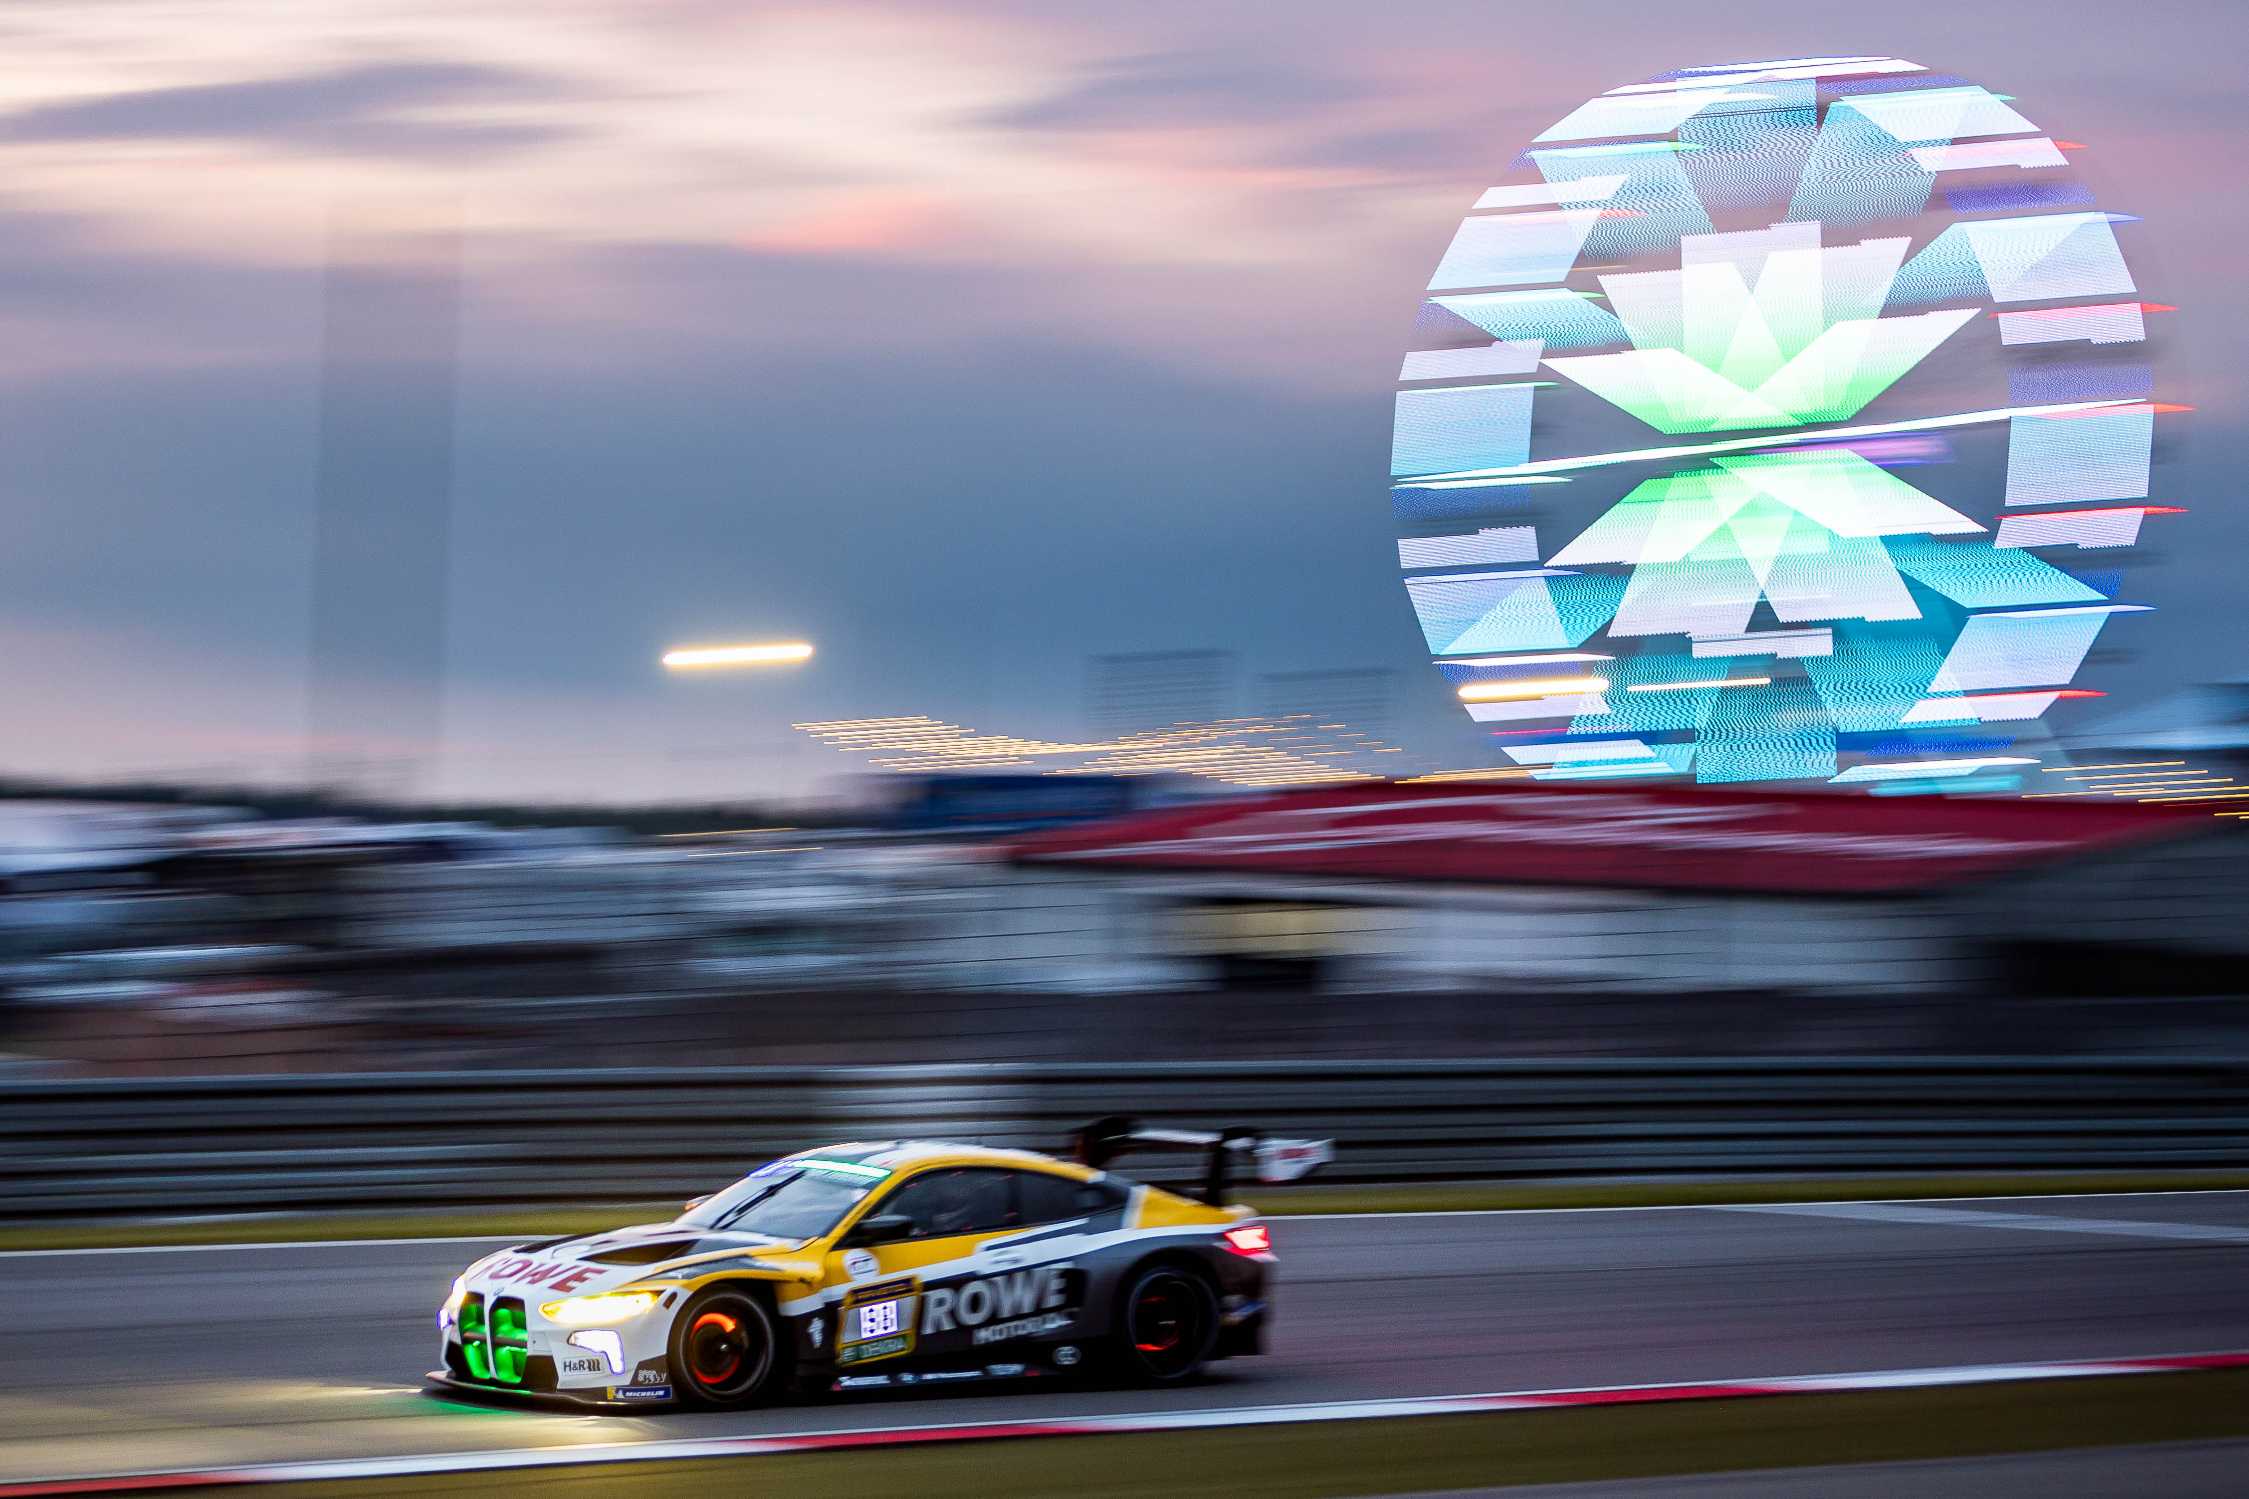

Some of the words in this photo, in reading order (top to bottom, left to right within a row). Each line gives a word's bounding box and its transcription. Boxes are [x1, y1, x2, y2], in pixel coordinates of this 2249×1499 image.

[921, 1265, 1069, 1335] ROWE
[563, 1359, 586, 1373] H&R
[624, 1389, 665, 1397] MICHELIN
